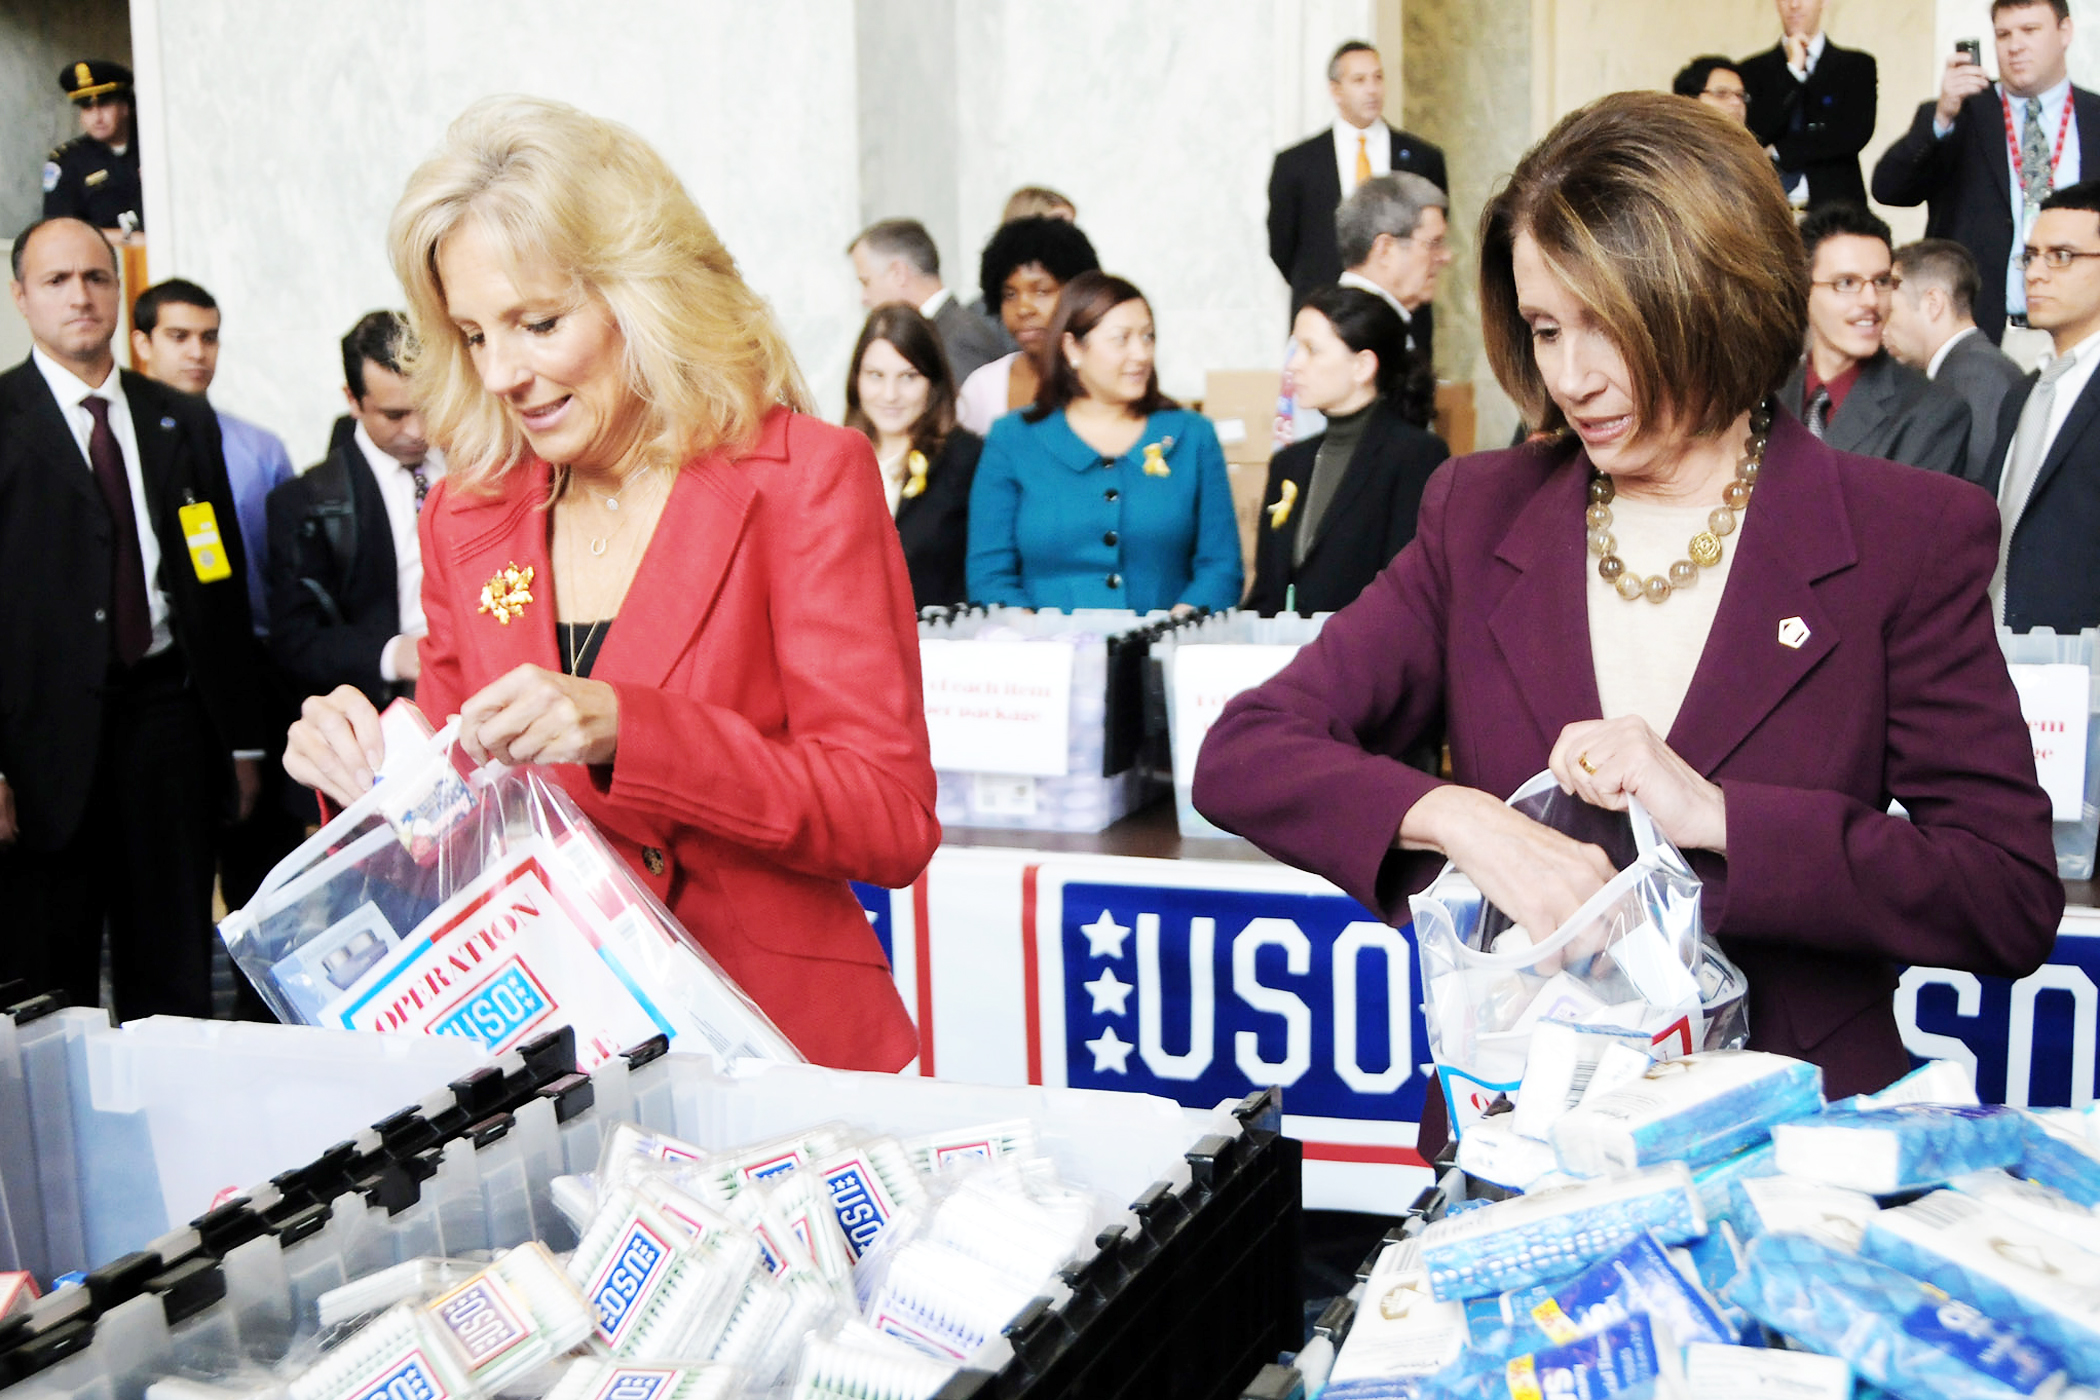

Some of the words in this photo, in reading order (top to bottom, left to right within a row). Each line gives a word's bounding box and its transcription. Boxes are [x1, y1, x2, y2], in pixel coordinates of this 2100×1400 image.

[375, 893, 540, 1034] OPERATION
[1136, 912, 1412, 1095] USO
[1893, 960, 2099, 1108] SO
[832, 1184, 882, 1243] USO
[449, 1297, 504, 1348] USO
[600, 1249, 651, 1316] USO
